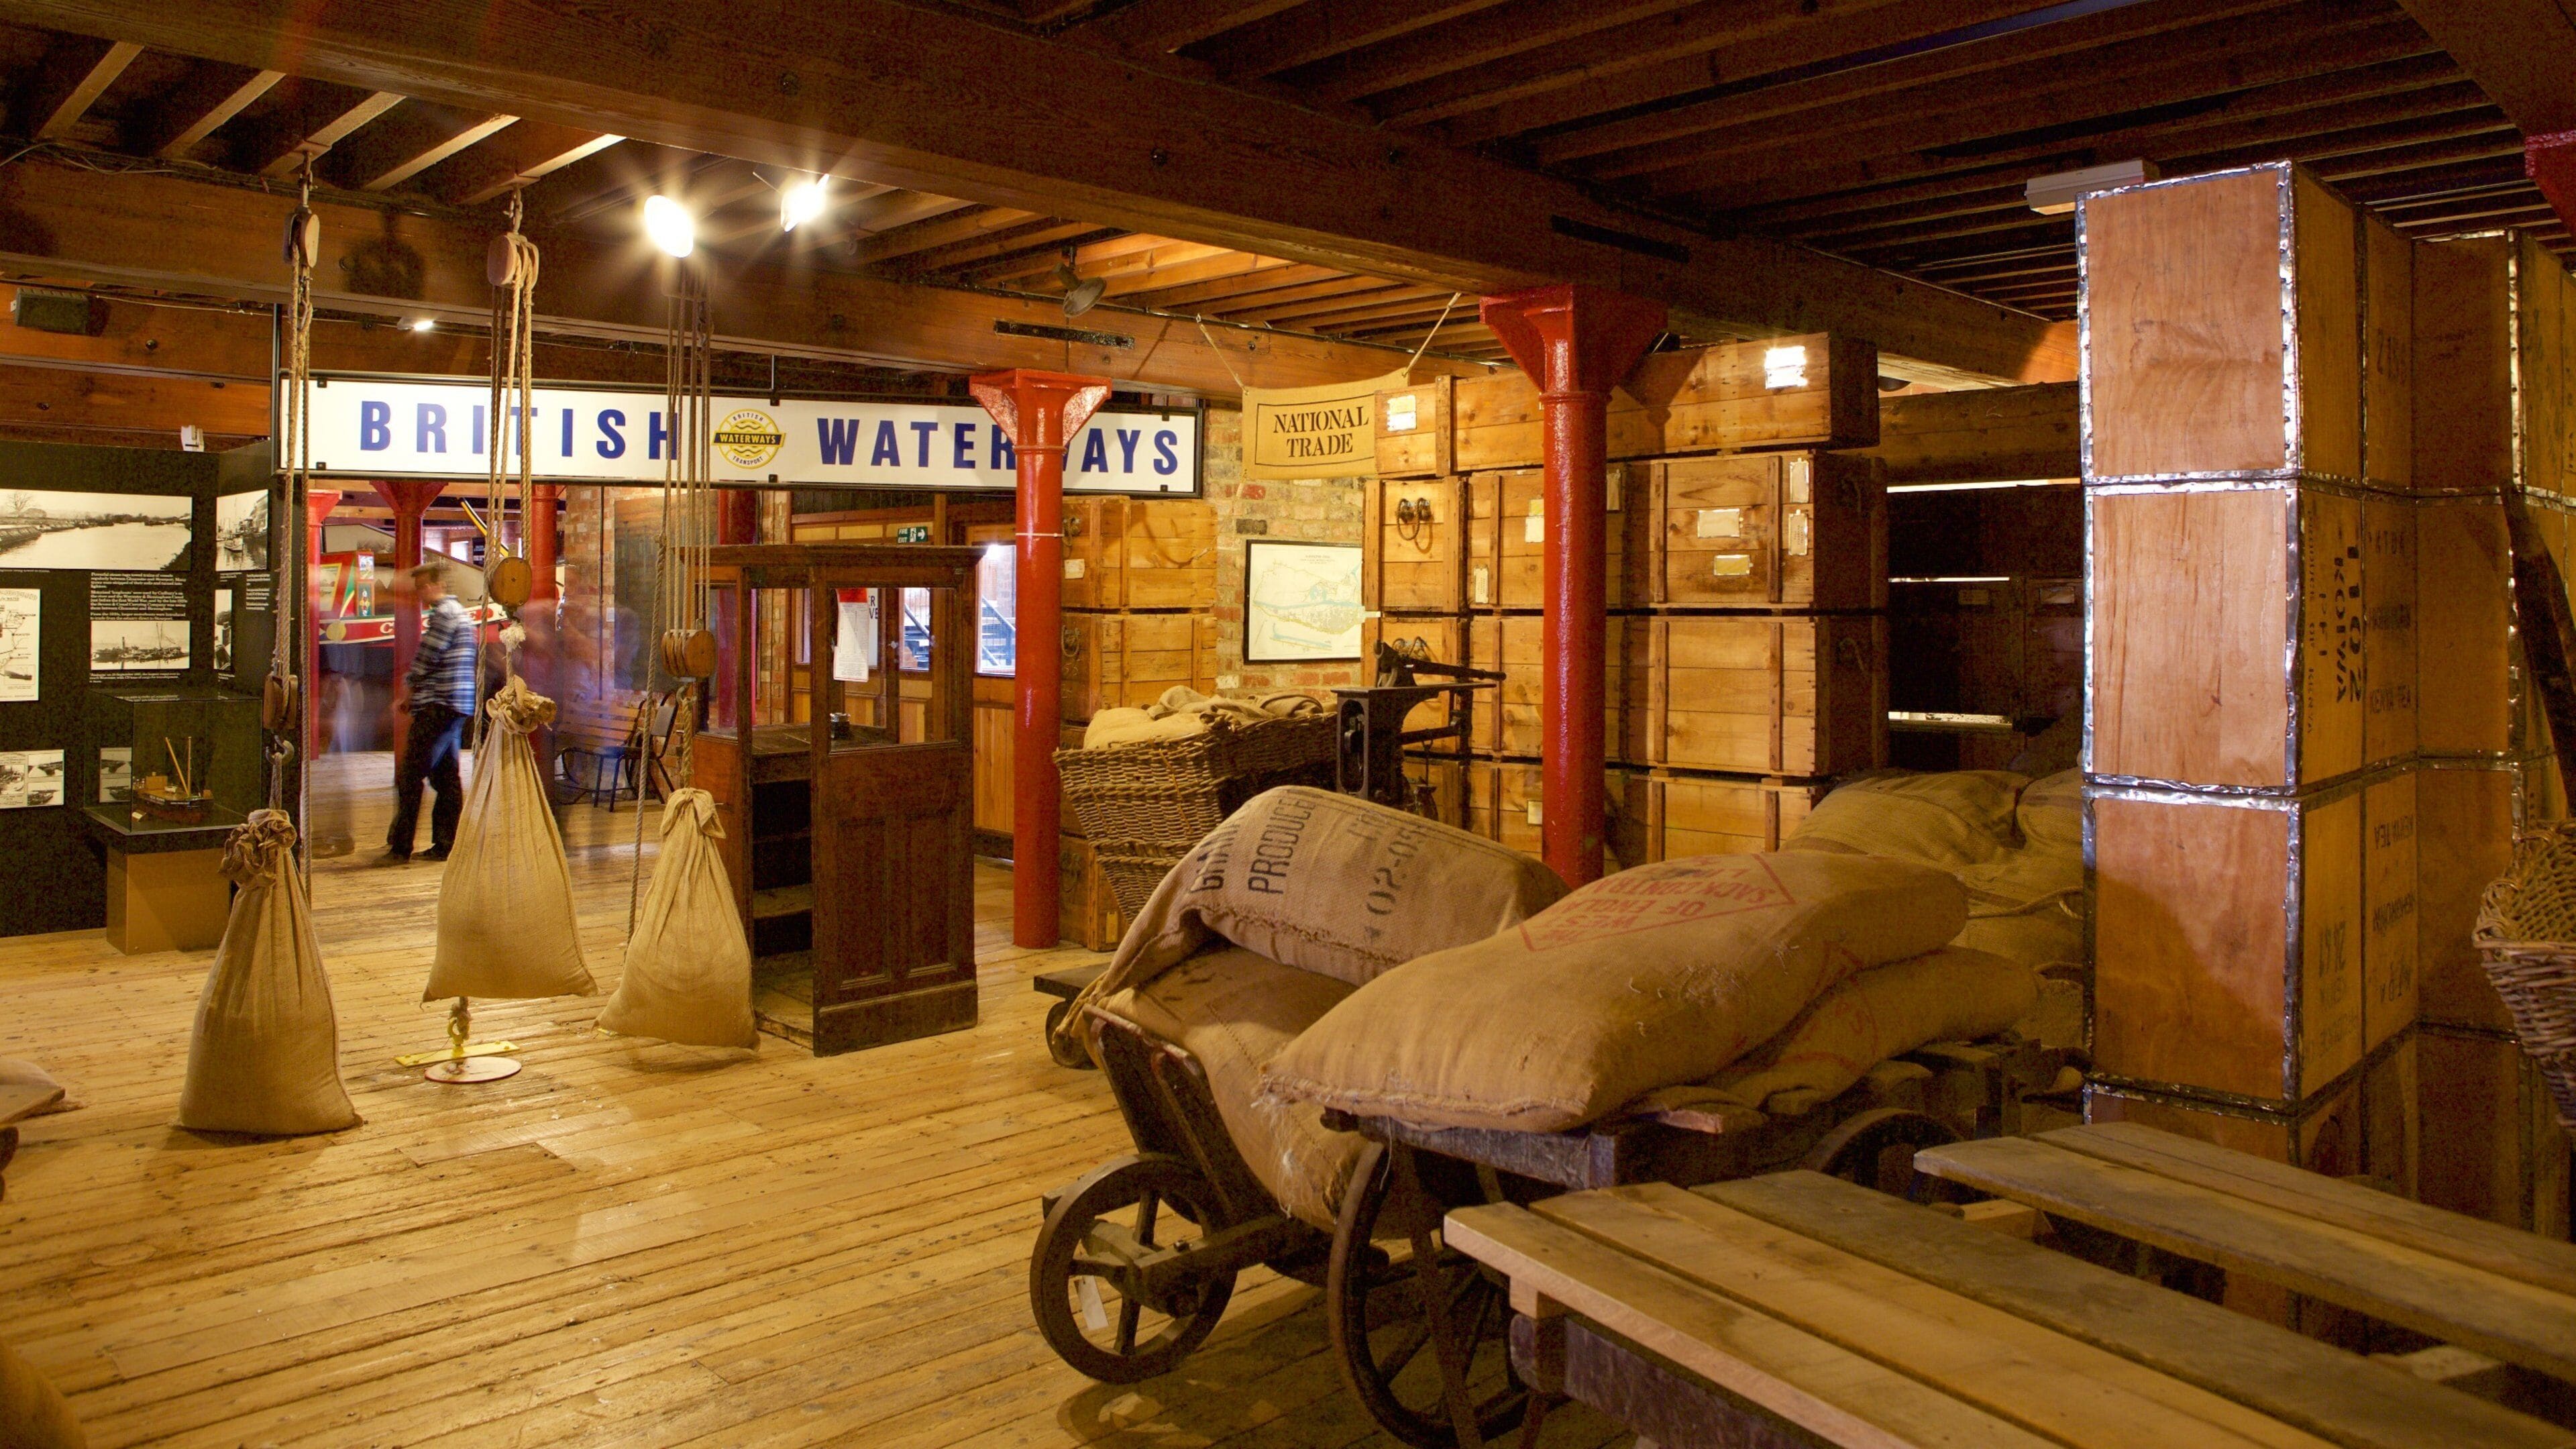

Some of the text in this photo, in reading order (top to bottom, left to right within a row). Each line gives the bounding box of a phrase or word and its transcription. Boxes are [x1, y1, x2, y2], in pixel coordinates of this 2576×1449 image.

[733, 413, 763, 422] BRITISH
[1273, 407, 1369, 433] NATIONAL
[360, 400, 1179, 475] BRITISH WATERAYS
[719, 433, 776, 444] WATERWAYS
[1287, 433, 1353, 458] TRADE
[733, 455, 763, 466] TRANSPORT
[2334, 557, 2347, 704] KOIWA
[1248, 798, 1316, 894] PRODUCE
